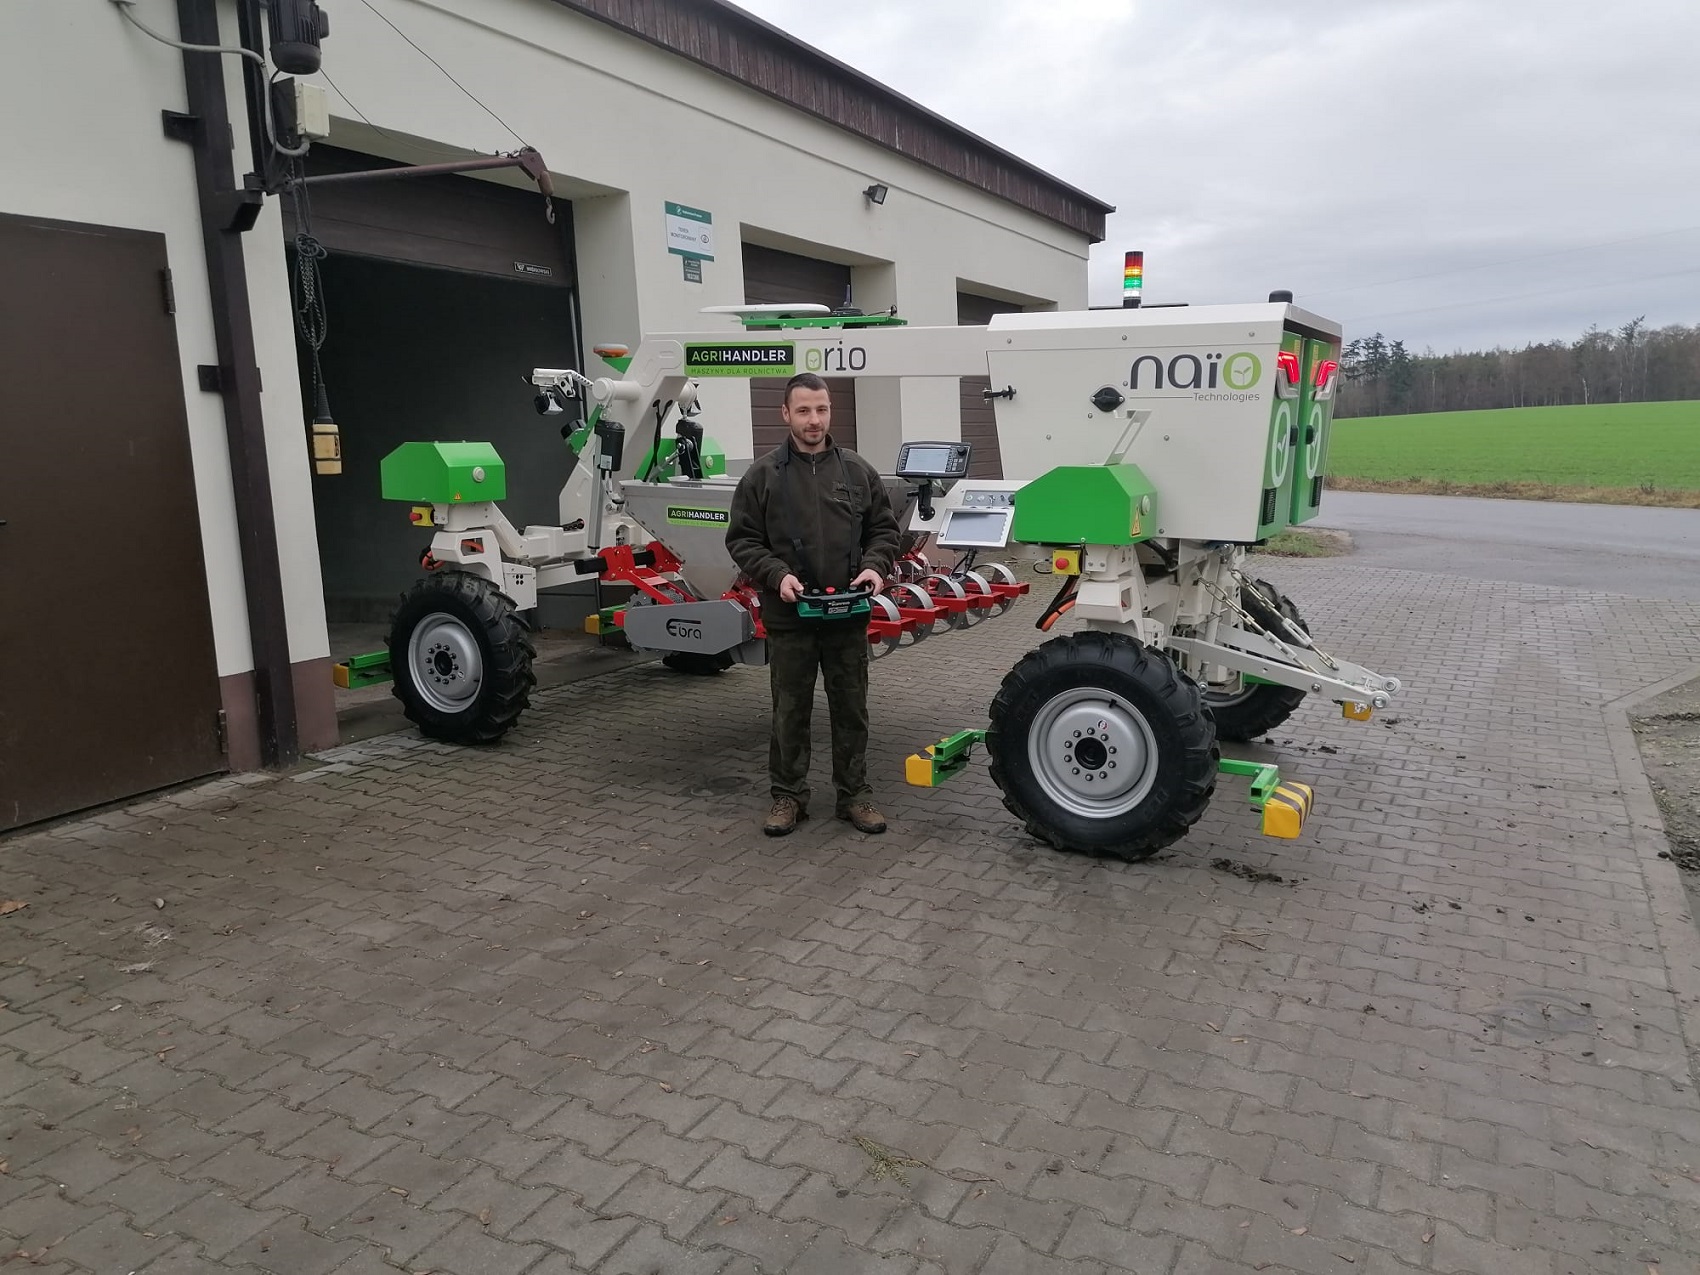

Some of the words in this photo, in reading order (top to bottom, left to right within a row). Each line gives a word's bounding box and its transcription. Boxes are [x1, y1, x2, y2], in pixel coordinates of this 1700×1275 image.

[691, 350, 787, 362] AGRIHANDLER
[805, 340, 867, 372] orio
[691, 367, 724, 375] MASZYNY
[726, 367, 741, 375] DLA
[743, 367, 787, 375] ROLNICTWA
[1193, 392, 1260, 402] Technologies
[671, 509, 725, 520] AGRIHANDLER
